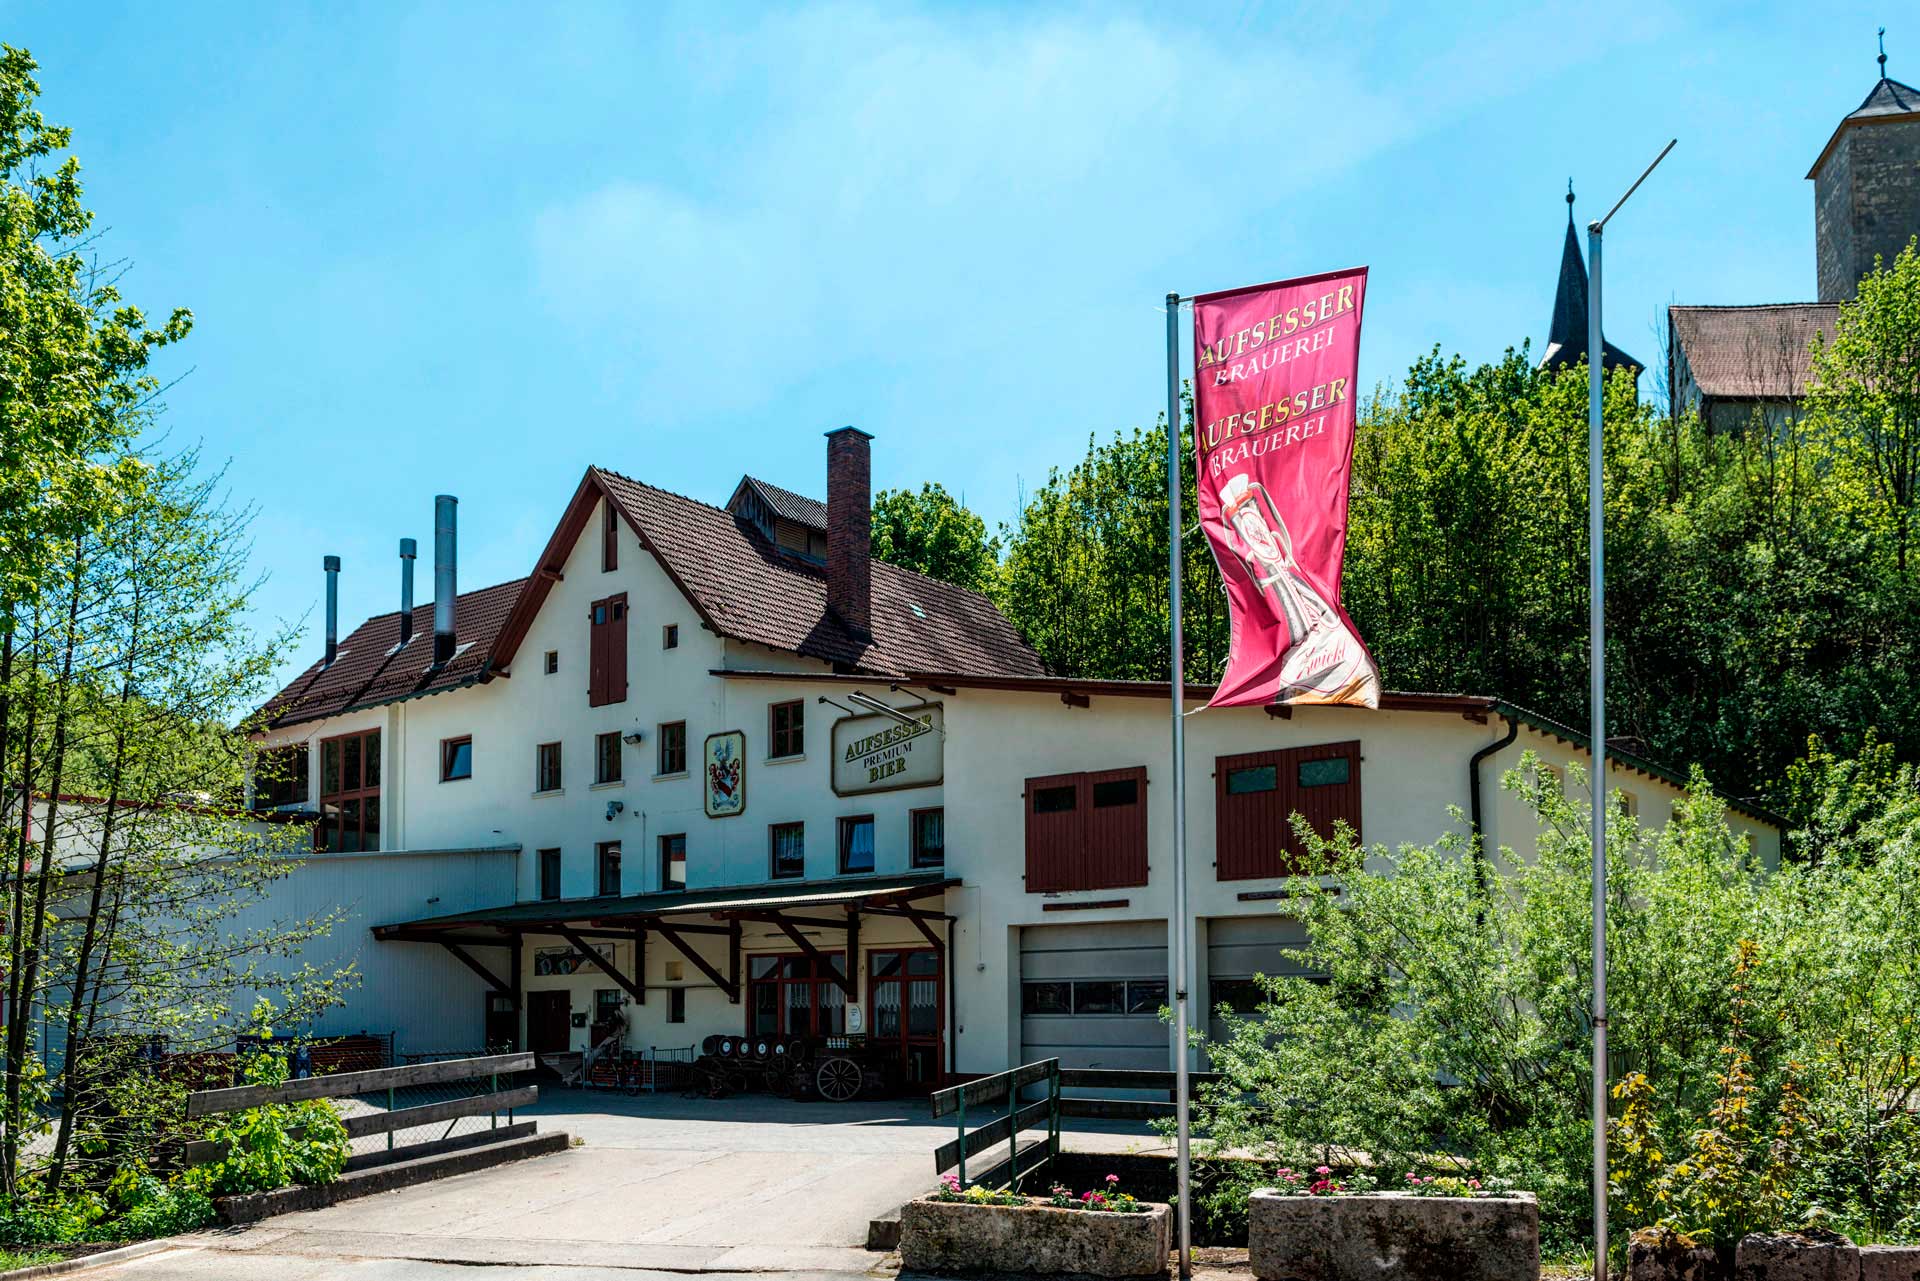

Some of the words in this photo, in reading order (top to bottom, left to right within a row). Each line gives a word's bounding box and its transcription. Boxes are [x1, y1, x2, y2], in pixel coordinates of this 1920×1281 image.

[1197, 284, 1355, 369] AUFSESSER
[1213, 325, 1336, 387] BRAUEREI
[1211, 415, 1327, 477] BRAUEREI
[845, 714, 932, 760] AUFSESSER
[864, 742, 912, 768] PREMIUM
[868, 757, 906, 783] BIER
